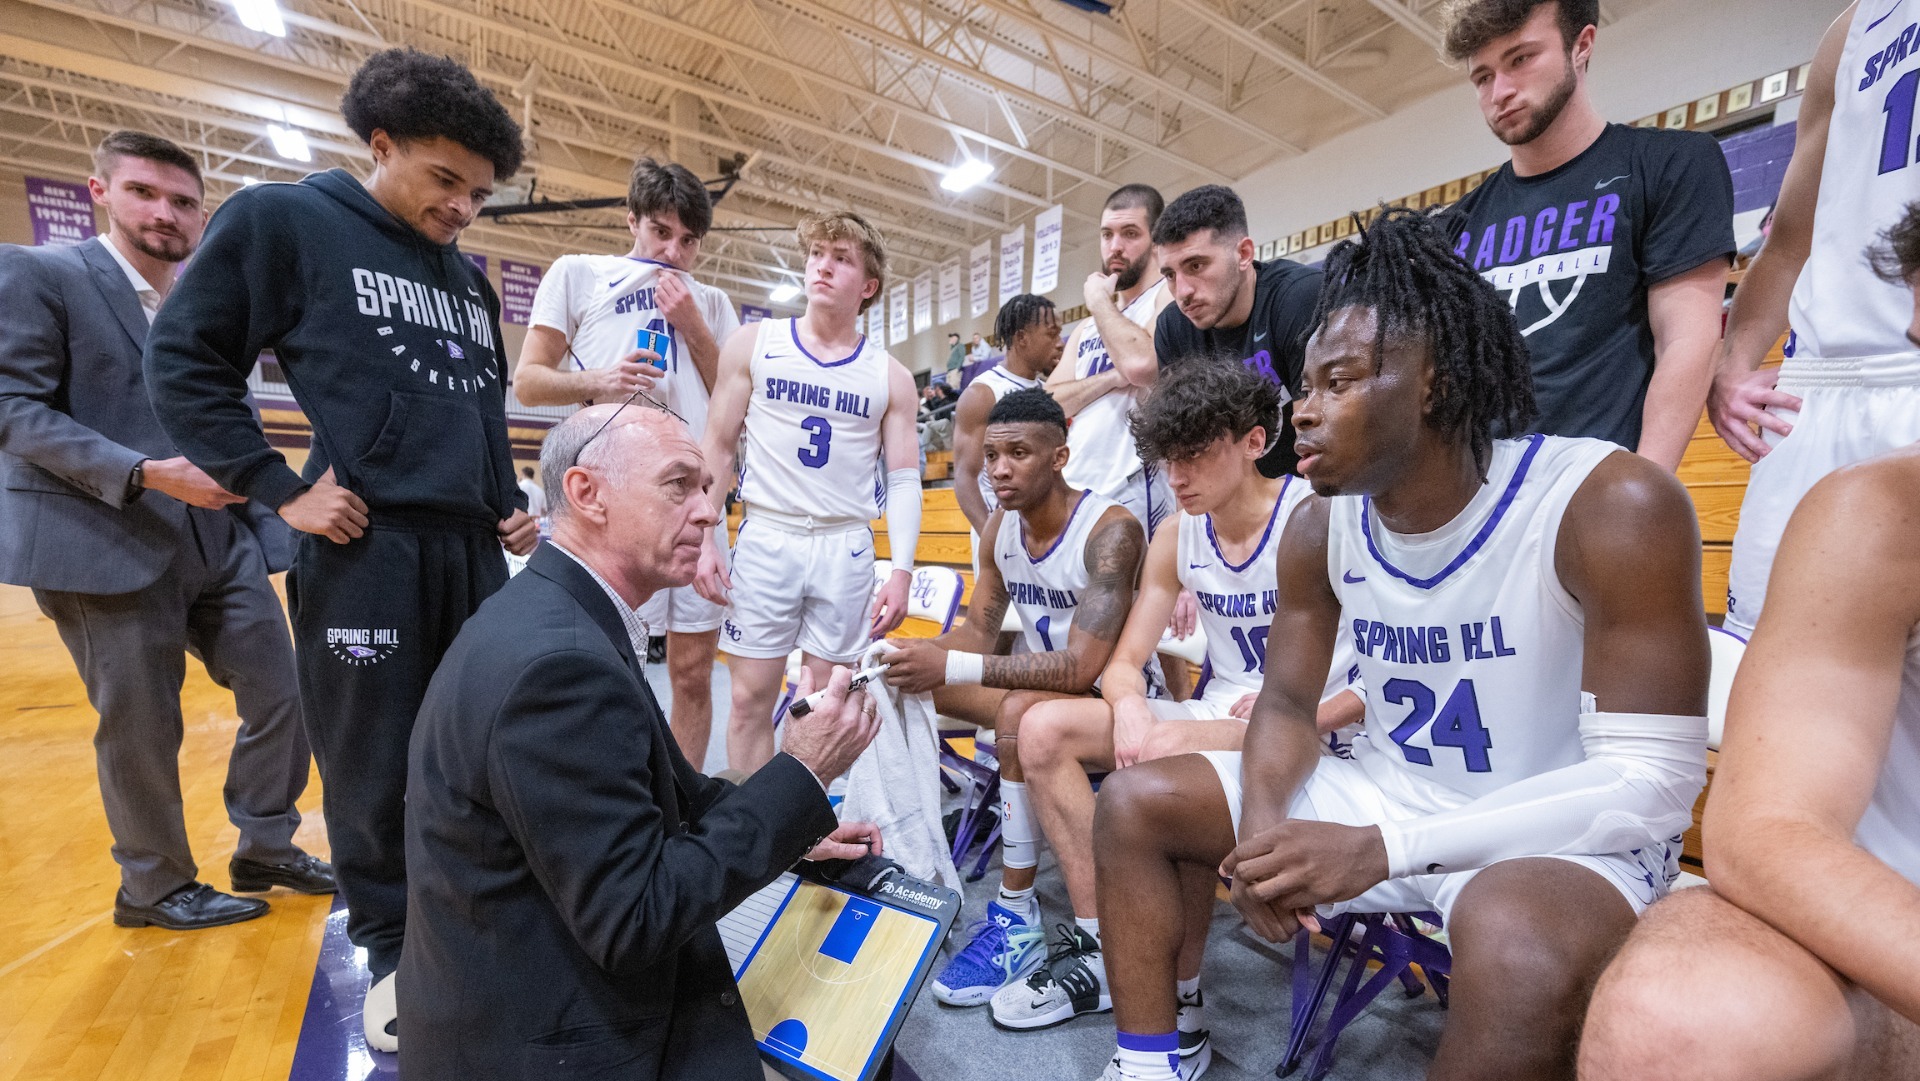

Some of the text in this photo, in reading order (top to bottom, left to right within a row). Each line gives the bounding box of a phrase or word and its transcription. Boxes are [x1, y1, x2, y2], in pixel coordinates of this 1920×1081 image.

[1877, 68, 1920, 176] 1
[29, 193, 92, 213] BASKETBALL
[43, 186, 76, 200] MEN'S
[35, 206, 91, 228] 1991-92
[48, 223, 82, 239] NAIA
[766, 377, 870, 419] SPRING HILL
[797, 415, 832, 469] 3
[1007, 580, 1047, 607] PRING
[1196, 591, 1256, 618] SPRING
[327, 628, 399, 645] SPRING HILL
[1036, 615, 1054, 652] 1
[1353, 616, 1516, 664] SPRING HLL
[1383, 677, 1493, 773] 24
[895, 886, 943, 910] Academy
